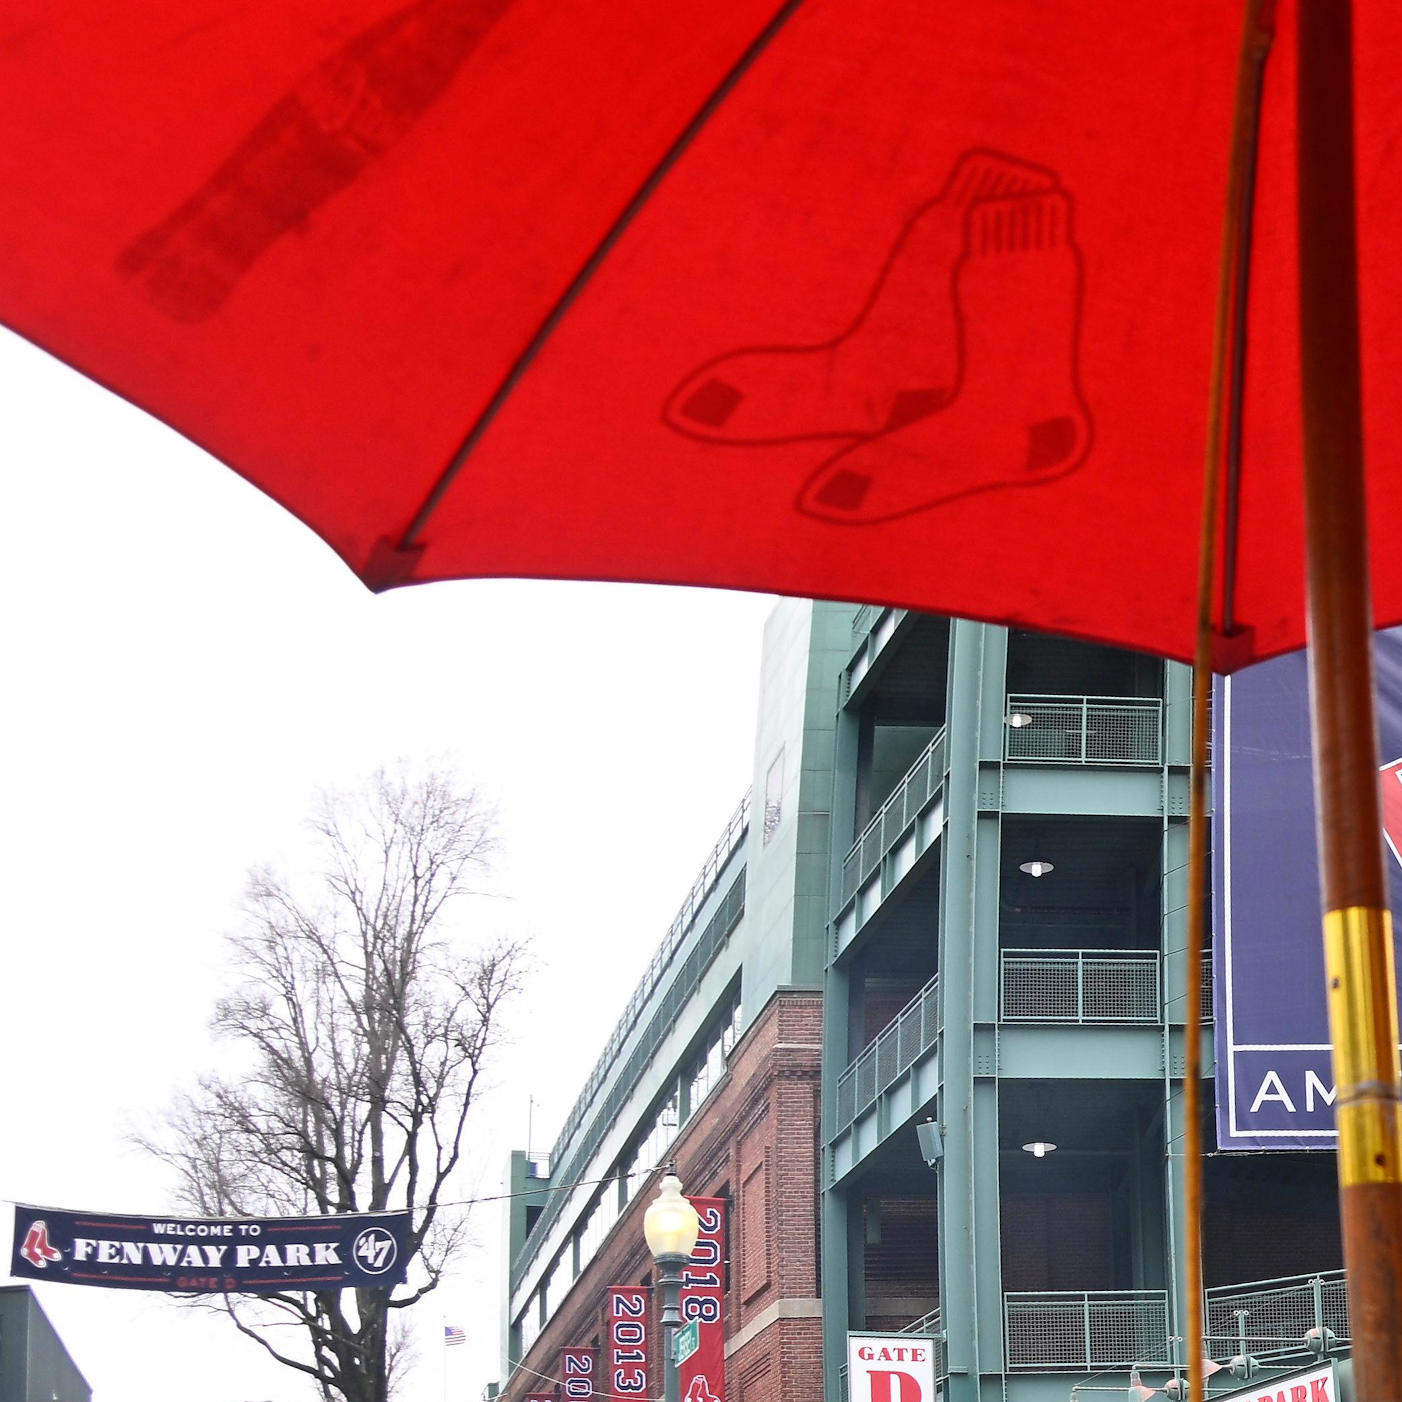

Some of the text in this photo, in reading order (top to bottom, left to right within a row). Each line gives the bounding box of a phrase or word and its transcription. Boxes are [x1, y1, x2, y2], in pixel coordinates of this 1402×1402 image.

[152, 1222, 261, 1237] WELCOME TO
[72, 1237, 343, 1268] FENWAY PARK
[682, 1207, 721, 1324] 2018
[175, 1275, 237, 1290] GATE D
[612, 1294, 647, 1393] 2013
[858, 1346, 927, 1363] GATE
